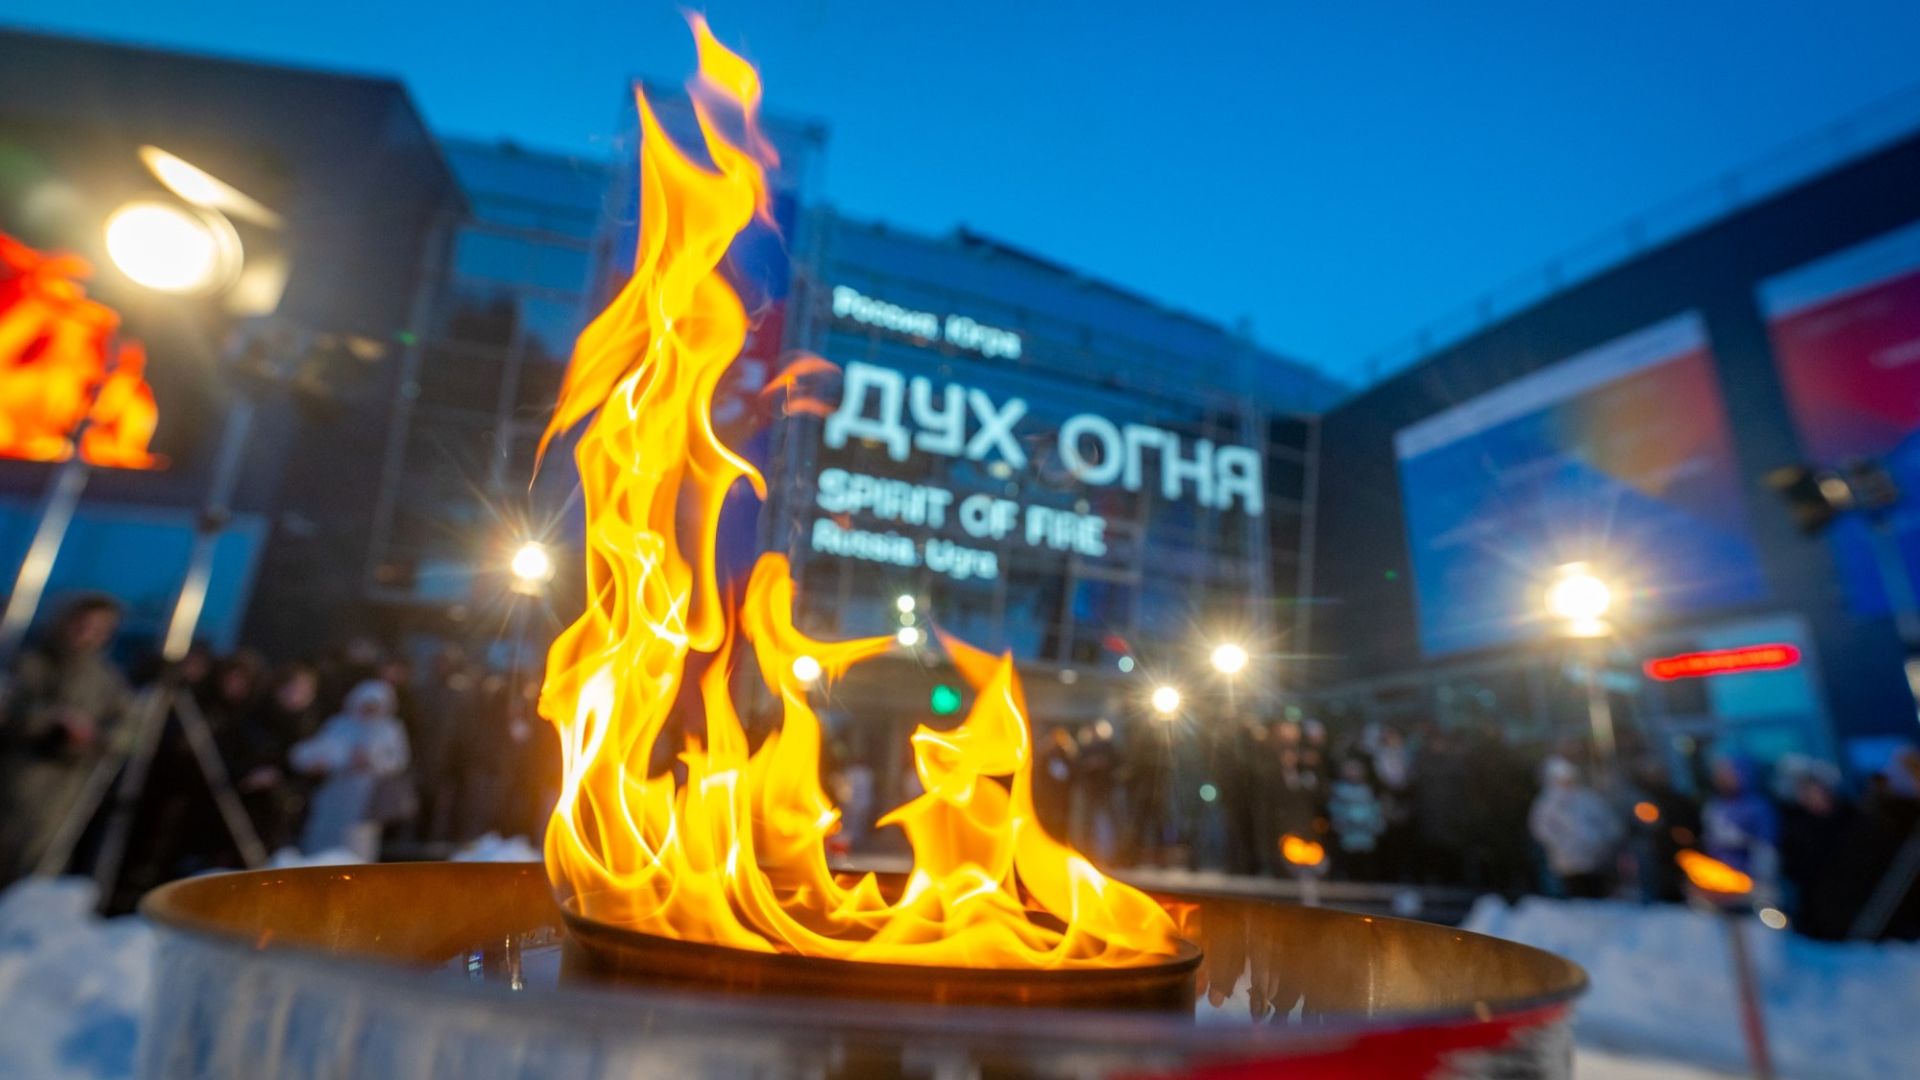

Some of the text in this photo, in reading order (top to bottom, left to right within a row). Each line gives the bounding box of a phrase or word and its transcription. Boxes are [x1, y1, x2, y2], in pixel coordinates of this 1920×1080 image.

[824, 360, 1263, 516] ДУХ ОГНЯ
[816, 467, 1107, 557] SPIRIT OF FIRE
